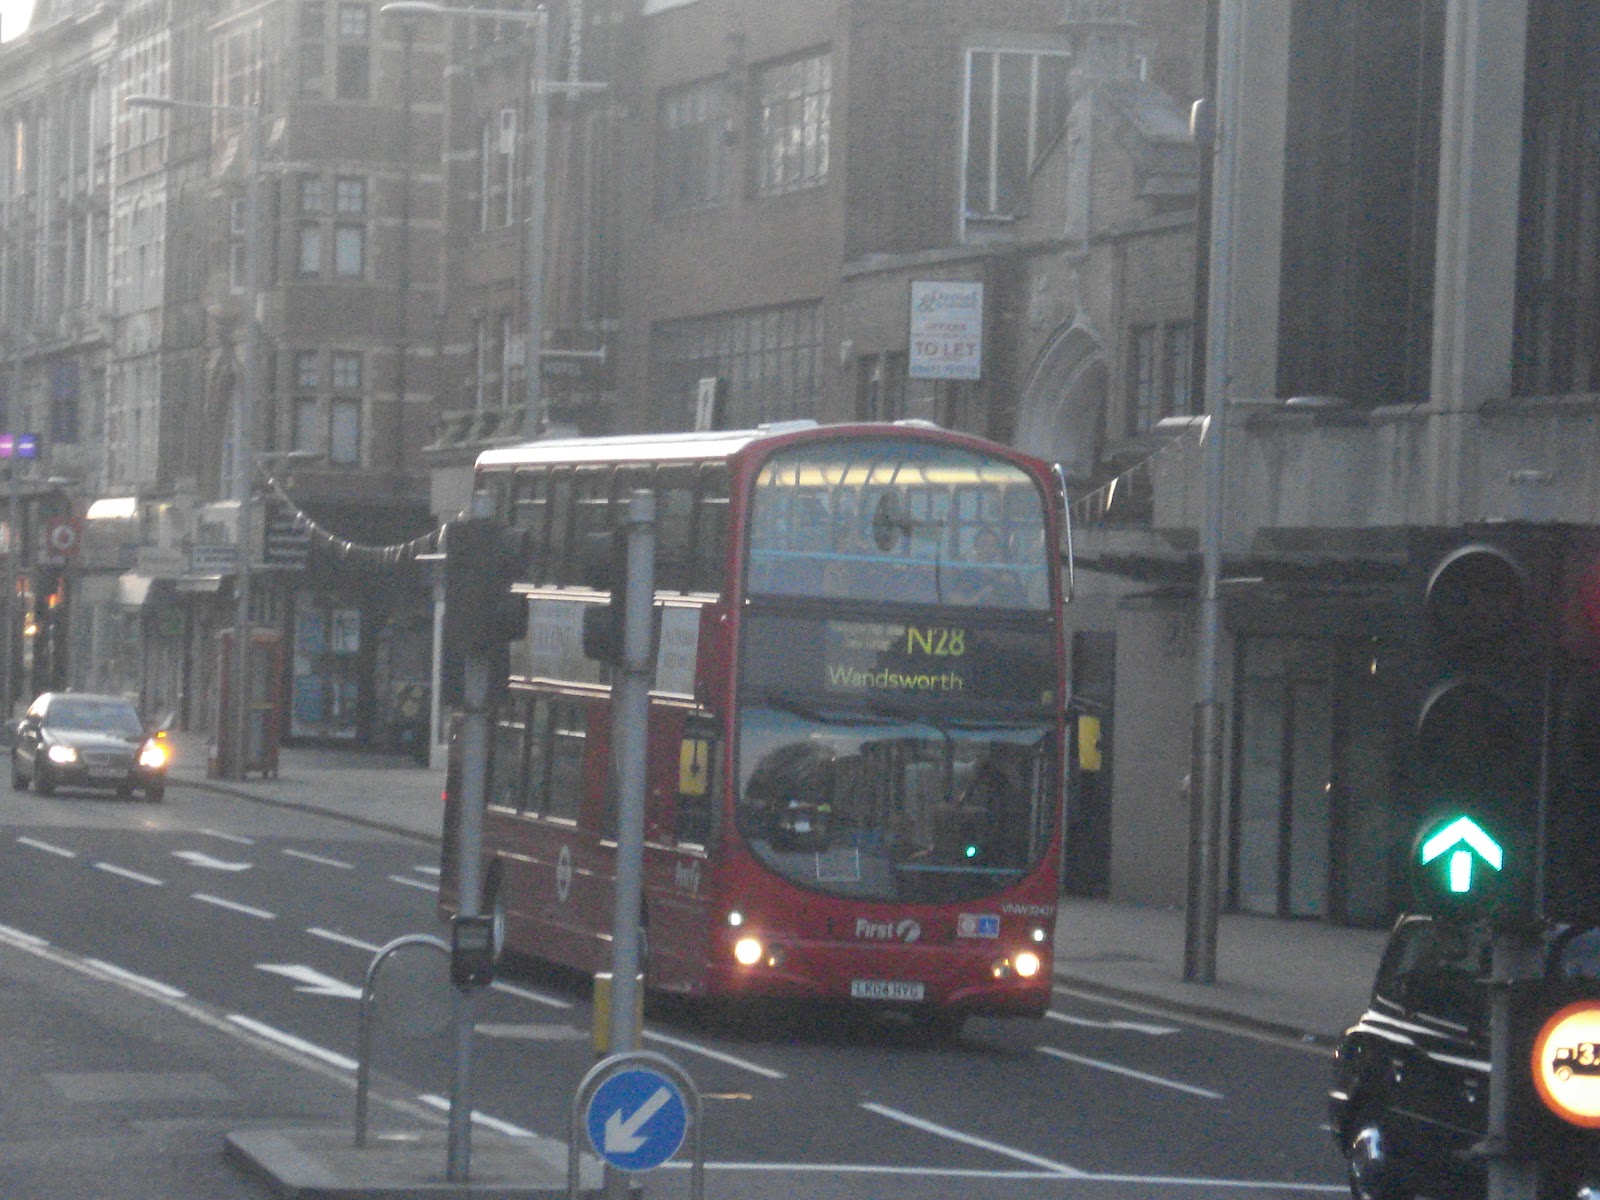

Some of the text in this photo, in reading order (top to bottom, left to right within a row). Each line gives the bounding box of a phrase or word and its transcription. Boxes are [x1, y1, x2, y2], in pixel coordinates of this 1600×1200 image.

[914, 341, 977, 359] TO LET
[906, 626, 966, 657] N28
[827, 663, 964, 691] Wandsworth
[855, 916, 893, 940] First
